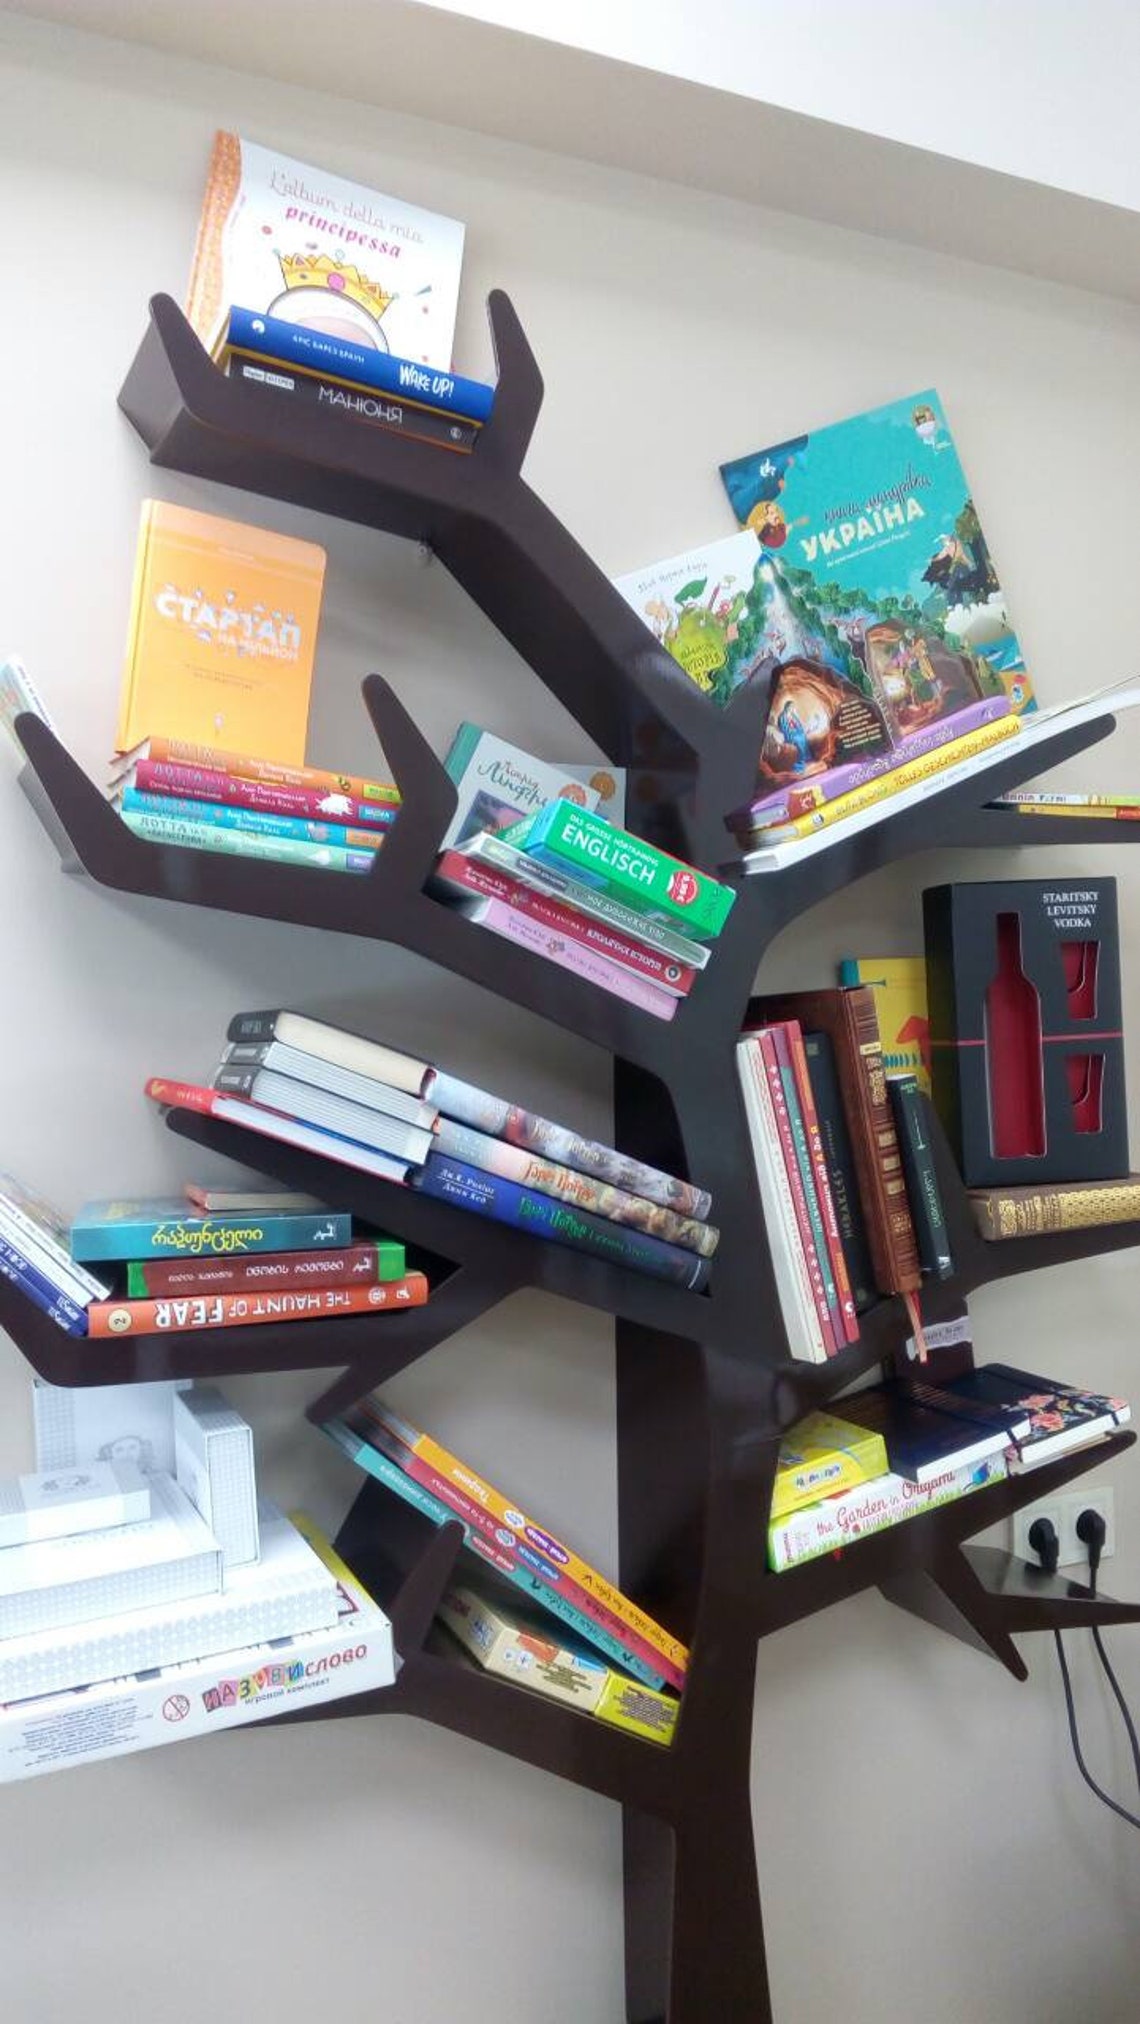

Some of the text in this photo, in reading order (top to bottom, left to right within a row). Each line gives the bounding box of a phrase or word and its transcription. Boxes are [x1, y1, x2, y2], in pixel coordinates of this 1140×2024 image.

[285, 206, 402, 259] principessa
[342, 200, 386, 231] della
[318, 385, 403, 424] МАНЮНЯ
[797, 495, 928, 561] УКРАЇНА
[155, 590, 302, 648] СТАРТАП
[561, 823, 657, 886] ENGLISCH
[1042, 890, 1100, 904] STARITSKY
[1046, 903, 1098, 917] LEVITSKY
[1054, 916, 1093, 929] VODKA
[154, 1291, 352, 1330] THE HAUNT OF FEAR
[836, 1498, 888, 1536] Garden
[901, 1470, 957, 1501] Origami
